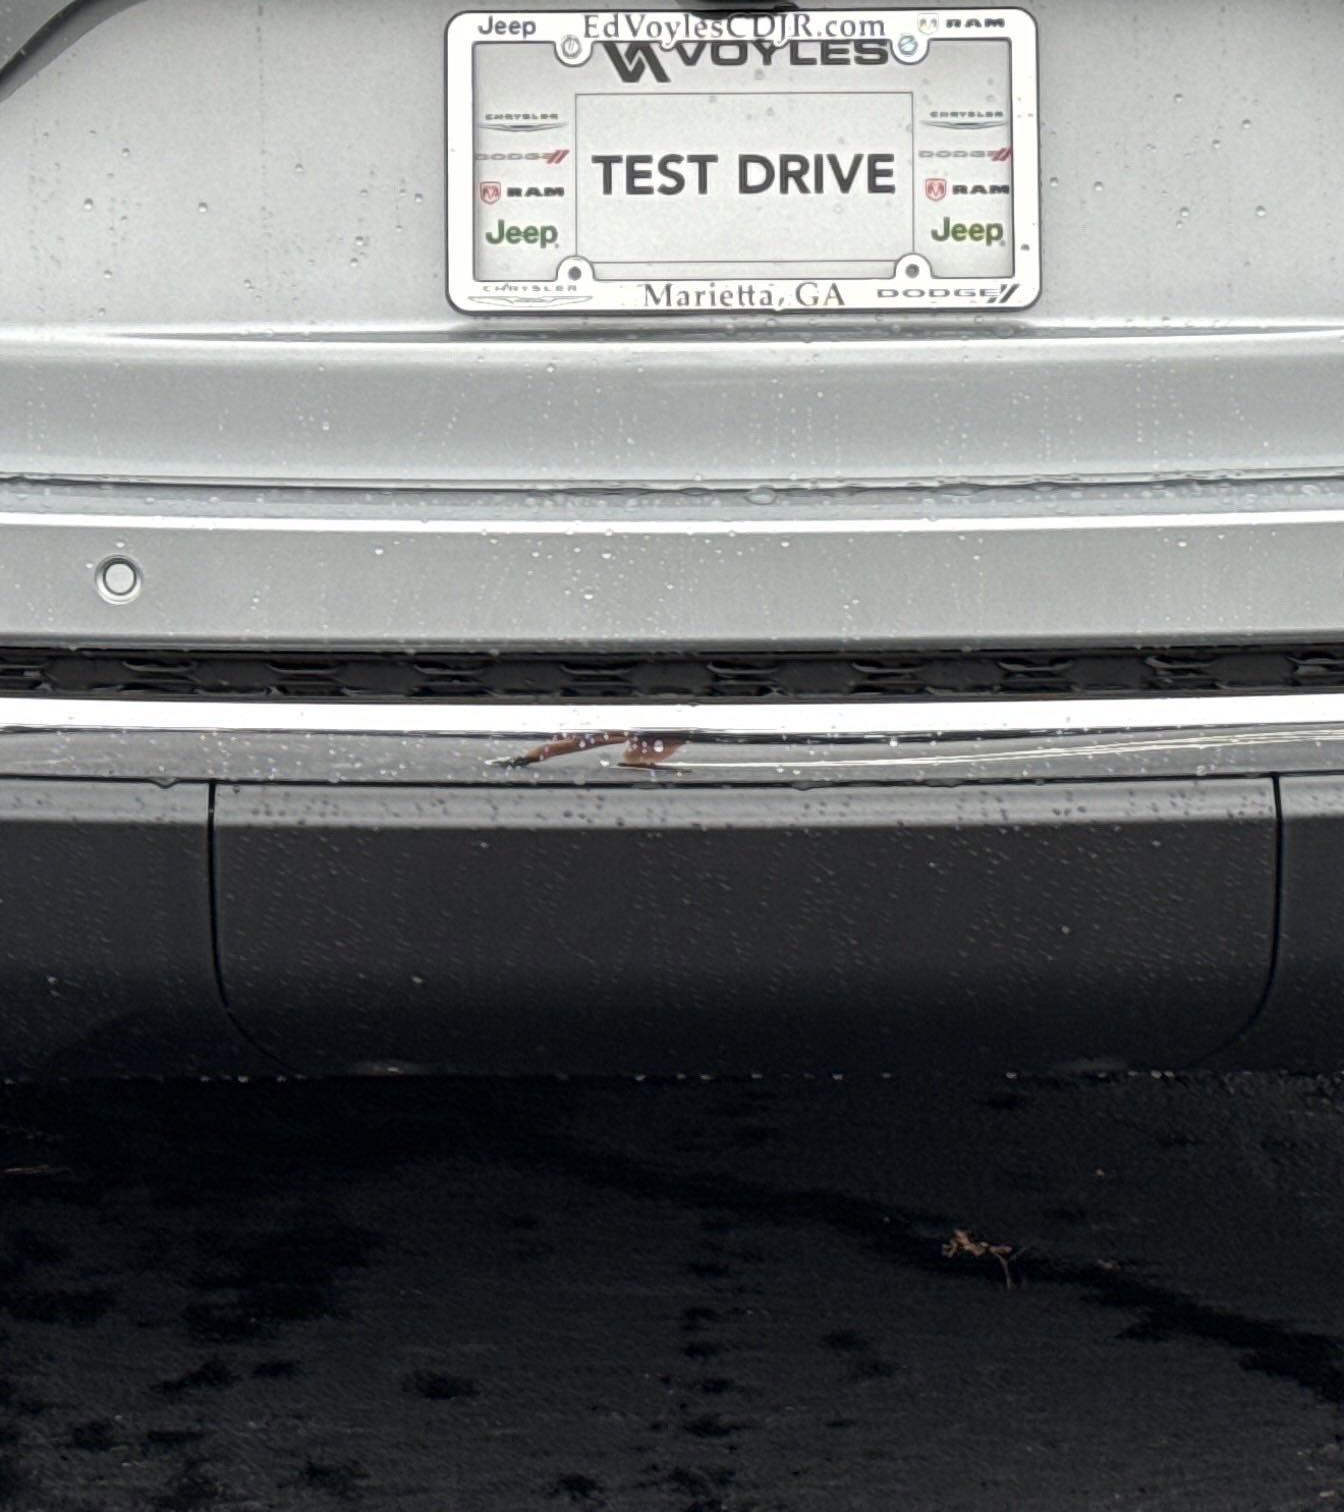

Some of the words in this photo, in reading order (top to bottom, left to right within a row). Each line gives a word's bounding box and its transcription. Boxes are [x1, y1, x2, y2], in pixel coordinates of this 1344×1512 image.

[478, 16, 537, 39] Jeep
[583, 13, 885, 44] EdVoylesCDJR.com
[945, 18, 1005, 28] RAM
[676, 40, 889, 66] VOYLES
[592, 154, 718, 195] TEST
[738, 153, 896, 194] DRIVE
[506, 187, 565, 197] RAM
[952, 184, 1010, 195] RAM
[485, 219, 558, 249] Jeep
[931, 216, 1004, 247] Jeep
[644, 282, 784, 307] Marietta,
[795, 282, 846, 306] GA
[876, 288, 1001, 299] DODGE
